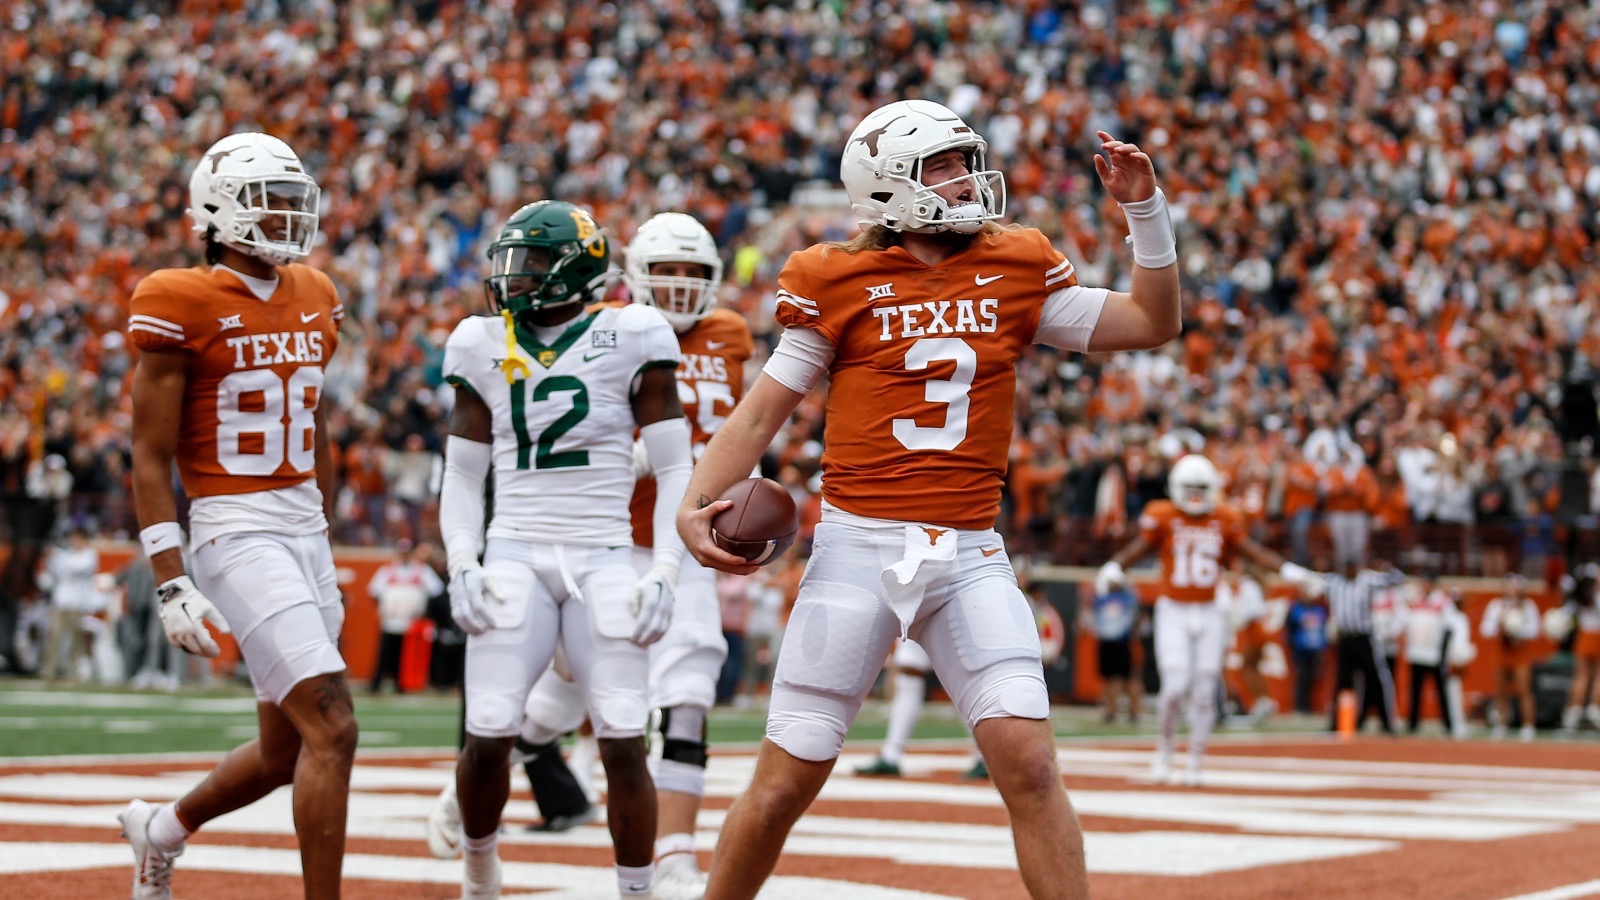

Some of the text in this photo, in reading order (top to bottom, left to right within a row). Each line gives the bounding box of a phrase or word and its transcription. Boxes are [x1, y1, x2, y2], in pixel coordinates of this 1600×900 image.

[866, 283, 896, 302] XII
[872, 298, 998, 341] TEXAS
[226, 331, 322, 368] TEXAS
[674, 353, 728, 382] XAS
[892, 337, 977, 451] 3
[216, 366, 324, 476] 88
[510, 375, 589, 470] 12
[1171, 541, 1220, 589] 16
